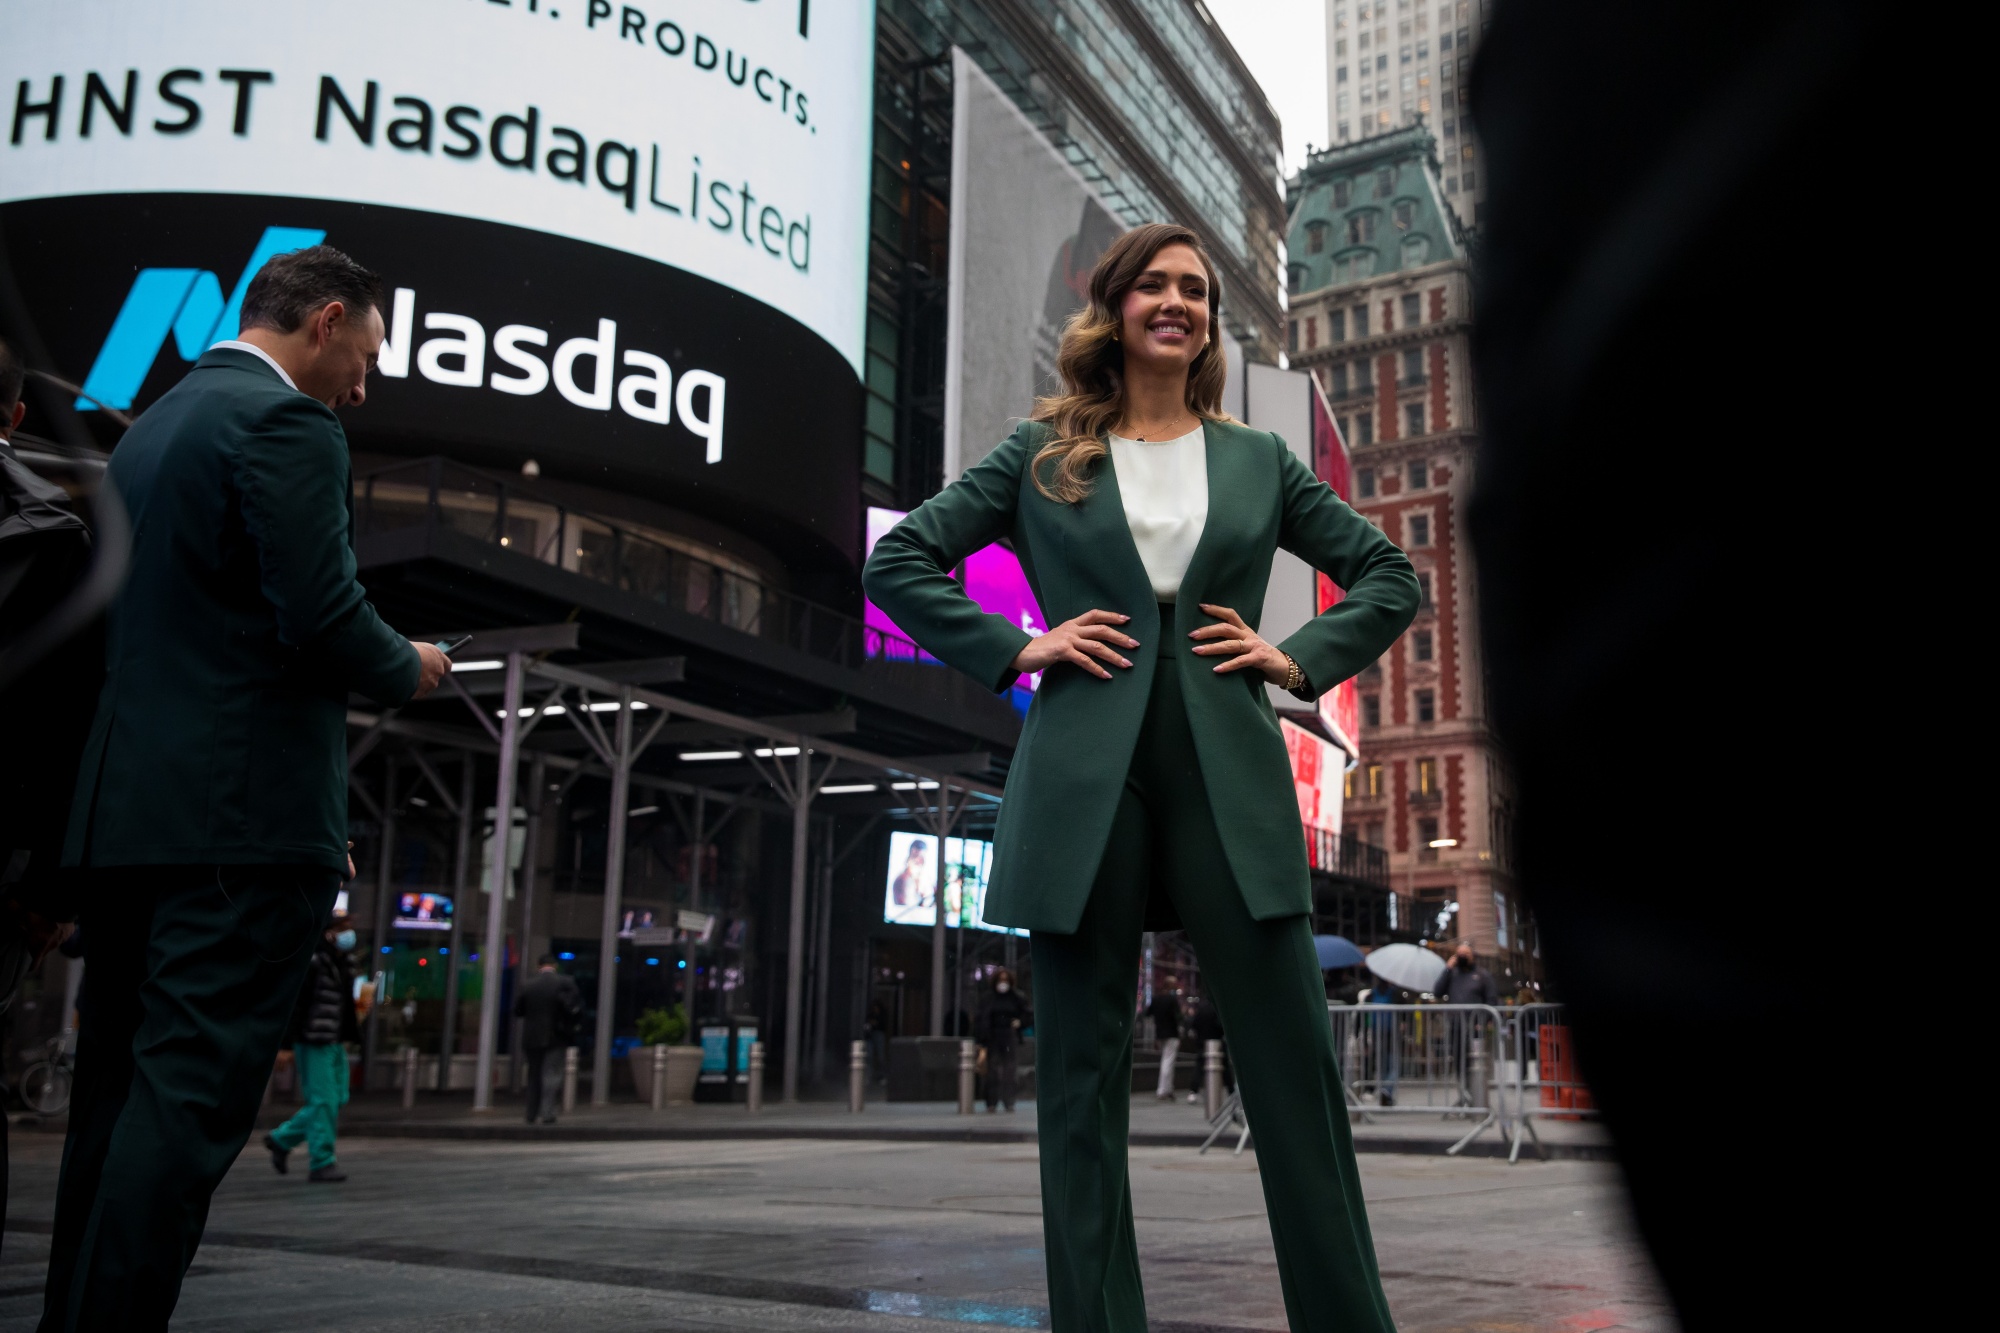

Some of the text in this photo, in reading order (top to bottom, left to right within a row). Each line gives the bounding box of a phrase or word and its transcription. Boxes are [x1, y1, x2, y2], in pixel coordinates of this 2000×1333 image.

[586, 0, 816, 134] PRODUCTS.
[10, 68, 812, 275] HNST NasdaqListed
